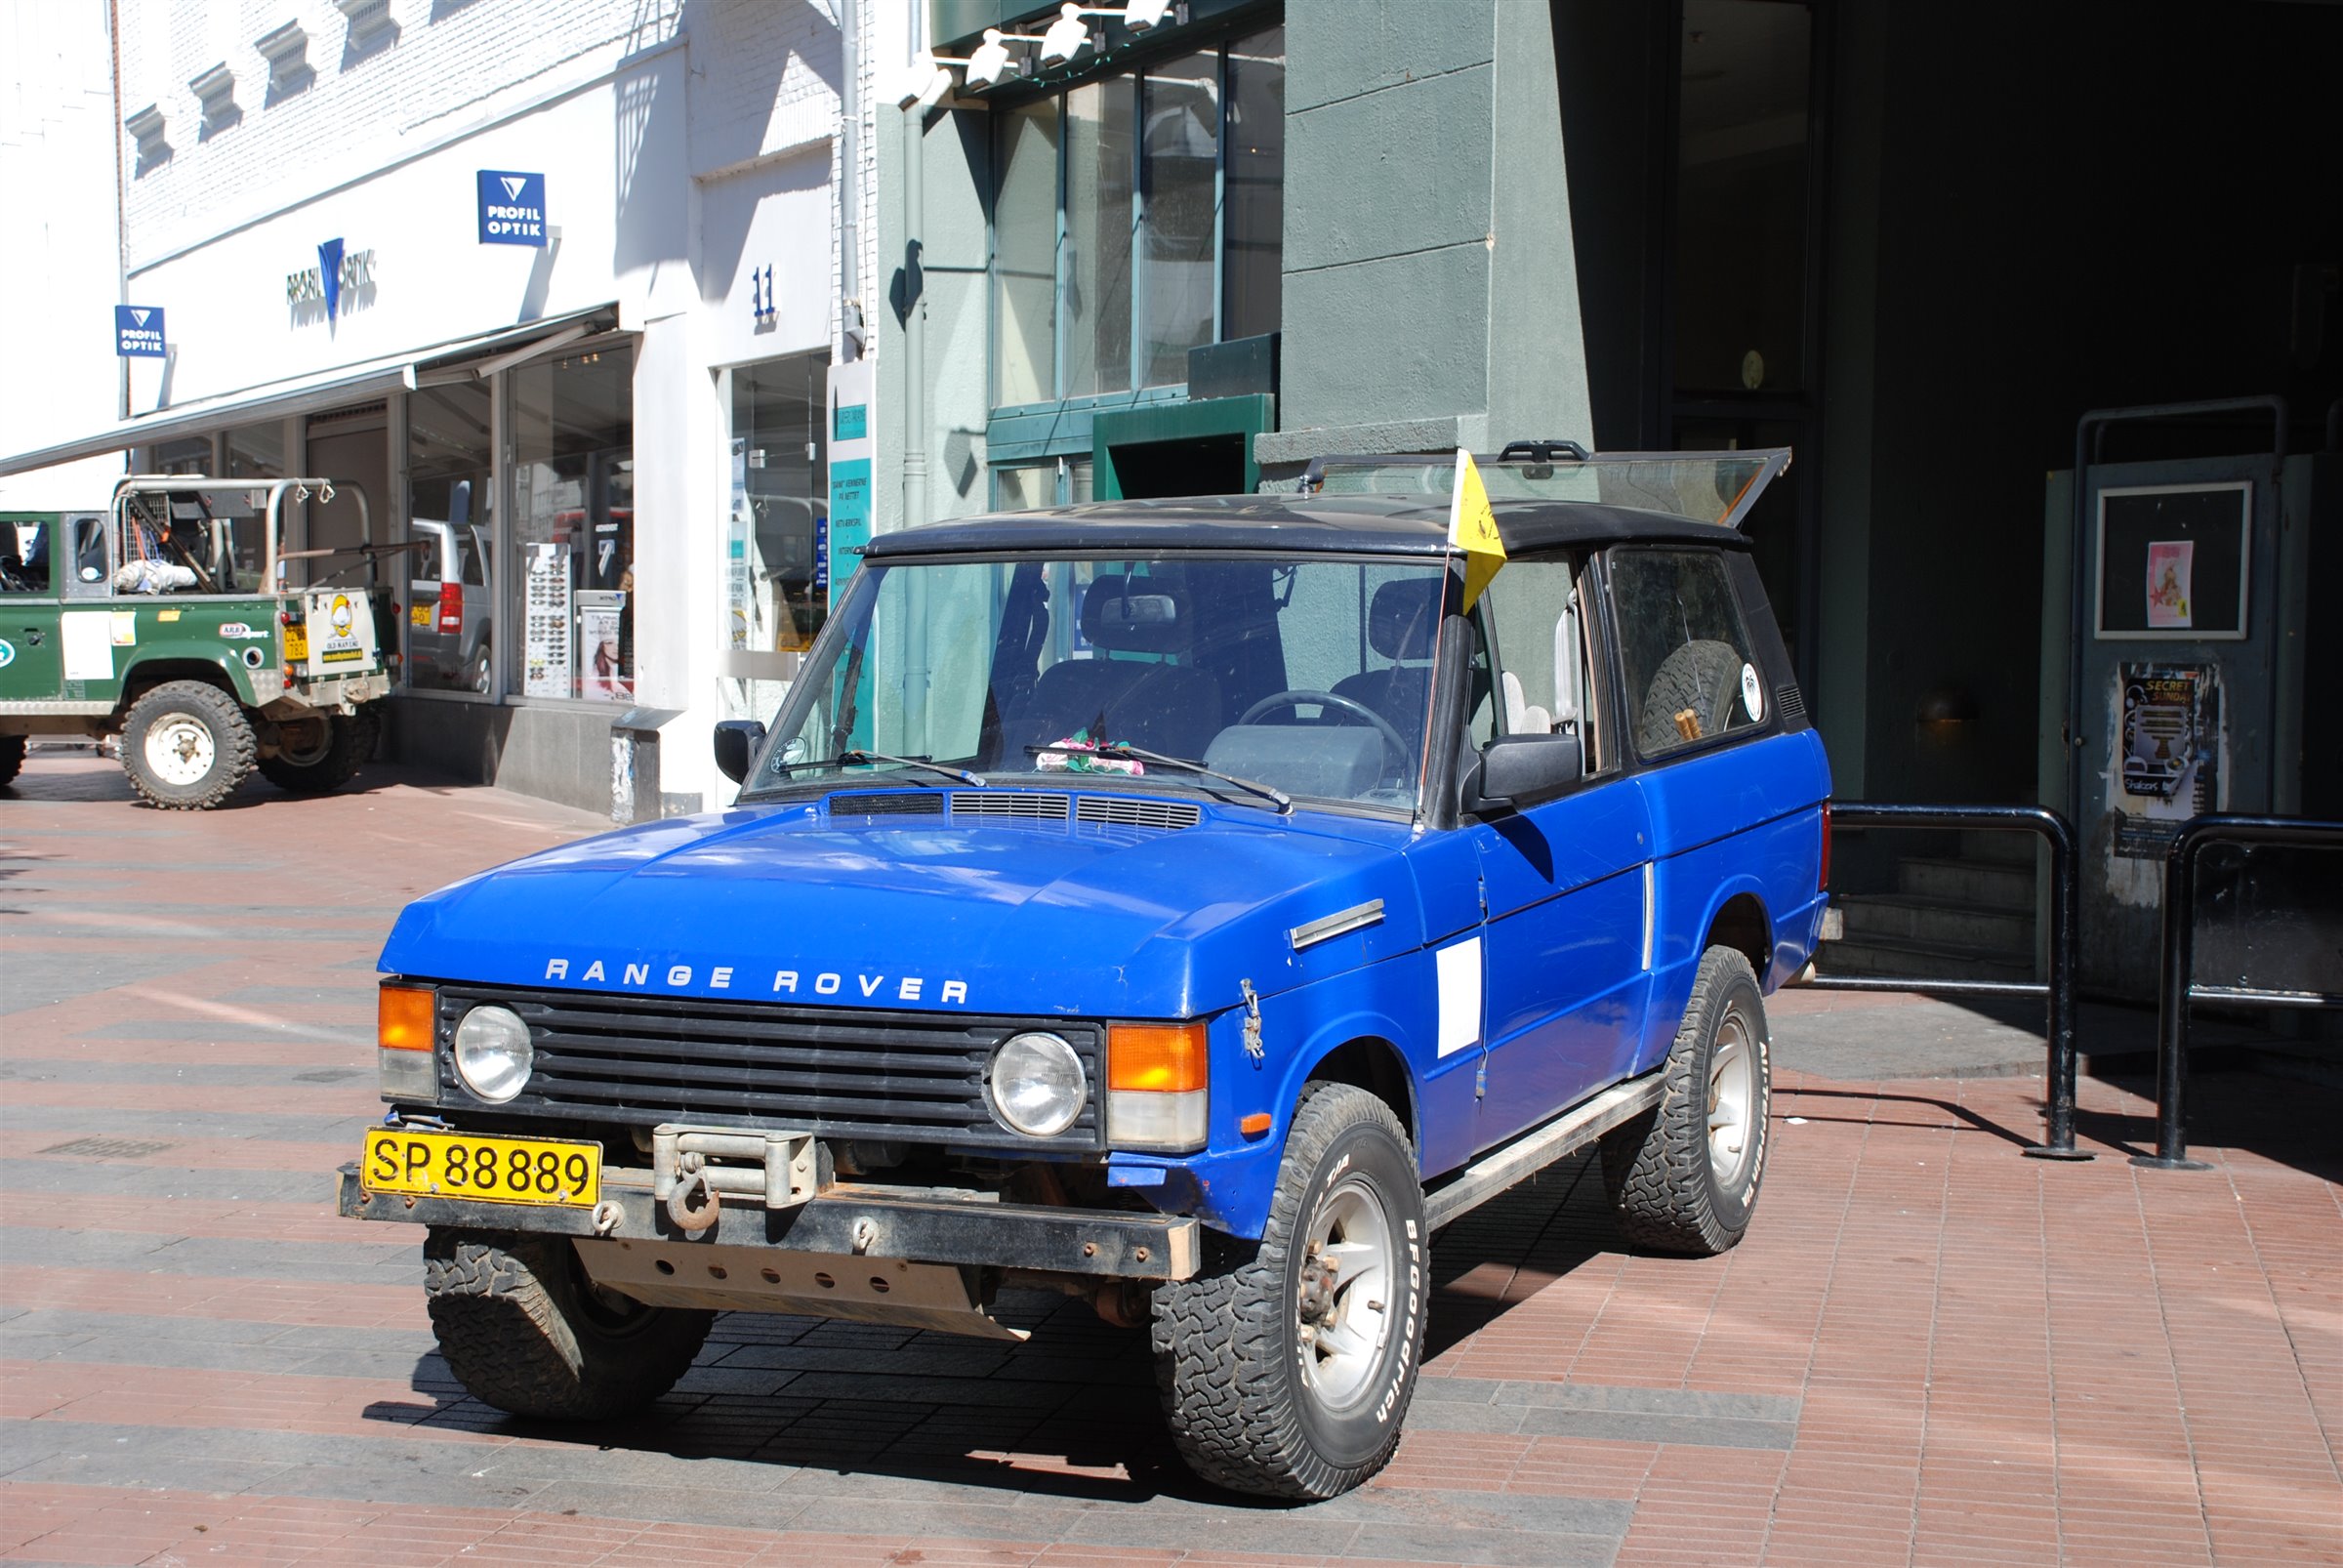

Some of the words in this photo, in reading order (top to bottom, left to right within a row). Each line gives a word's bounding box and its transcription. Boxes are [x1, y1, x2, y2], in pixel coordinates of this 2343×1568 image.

[487, 205, 541, 221] PROFIL
[487, 221, 541, 236] OPTIK
[753, 263, 776, 317] 11
[121, 329, 162, 341] PROFIL
[121, 340, 162, 351] OPTIK
[2145, 680, 2190, 691] SECRET
[545, 958, 734, 988] RANGE
[772, 970, 968, 1005] ROVER
[372, 1138, 432, 1184] SP
[1327, 1153, 1350, 1189] T/A
[1376, 1217, 1419, 1425] BFGoodrich
